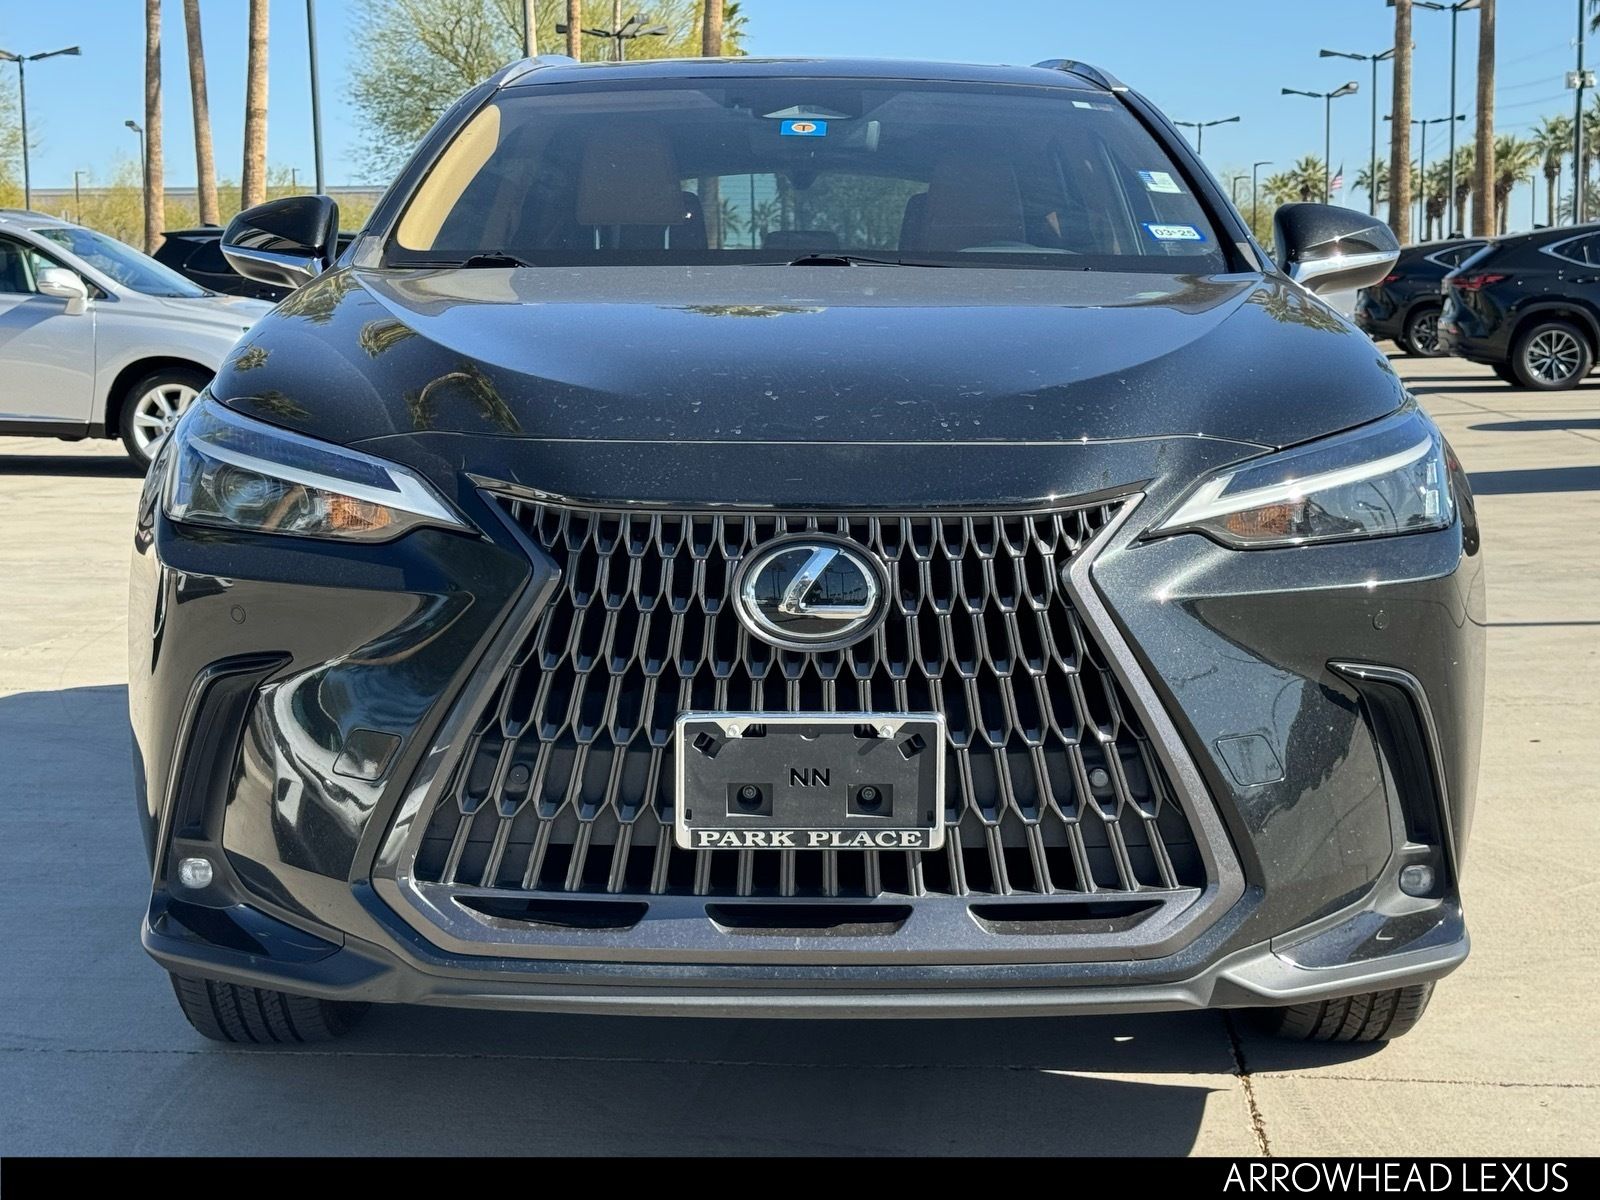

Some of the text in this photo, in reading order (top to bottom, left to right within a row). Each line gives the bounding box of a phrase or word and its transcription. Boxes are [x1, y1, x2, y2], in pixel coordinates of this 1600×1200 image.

[789, 767, 830, 787] NN
[698, 830, 922, 847] PARK PLACE
